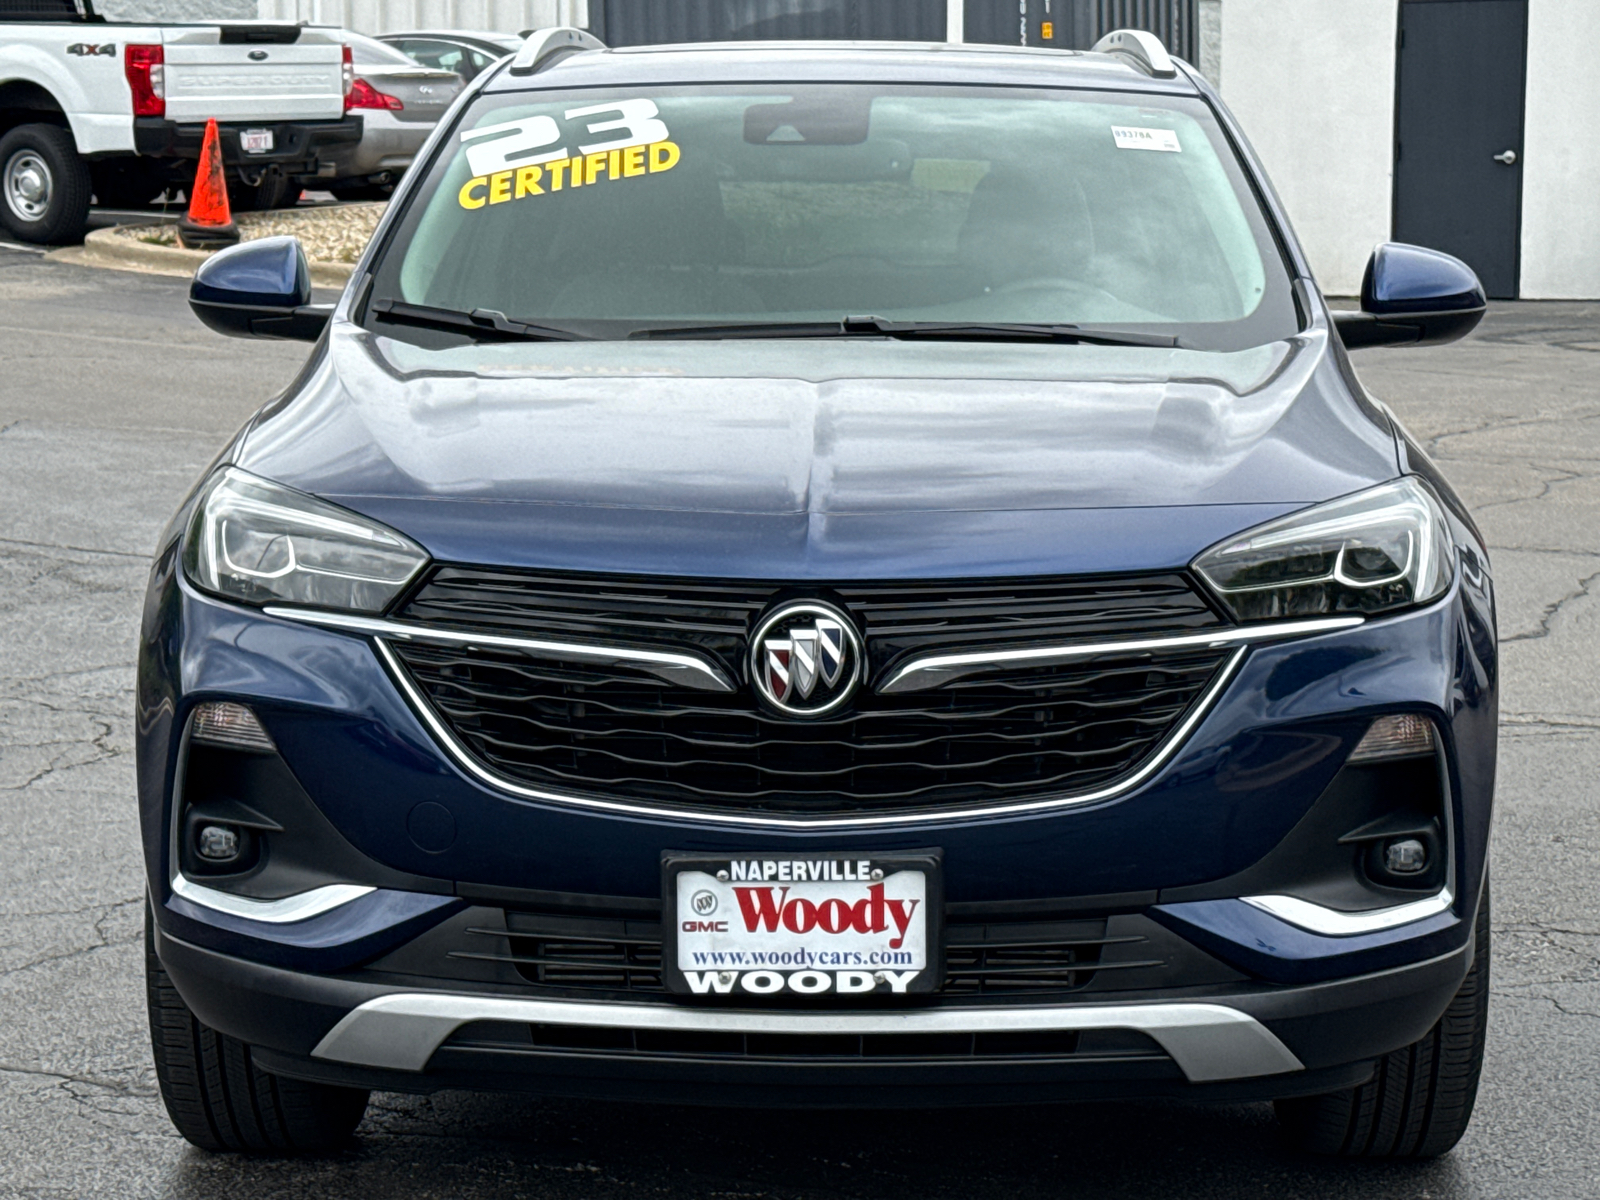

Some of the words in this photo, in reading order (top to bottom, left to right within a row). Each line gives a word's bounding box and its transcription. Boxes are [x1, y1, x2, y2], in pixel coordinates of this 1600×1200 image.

[460, 98, 669, 177] 23
[458, 141, 681, 210] CERTIFIED
[730, 860, 871, 881] NAPERVILLE
[682, 921, 729, 933] GMC
[732, 882, 920, 949] Woody
[692, 947, 913, 967] www.woodycars.com
[683, 970, 920, 994] WOODY
